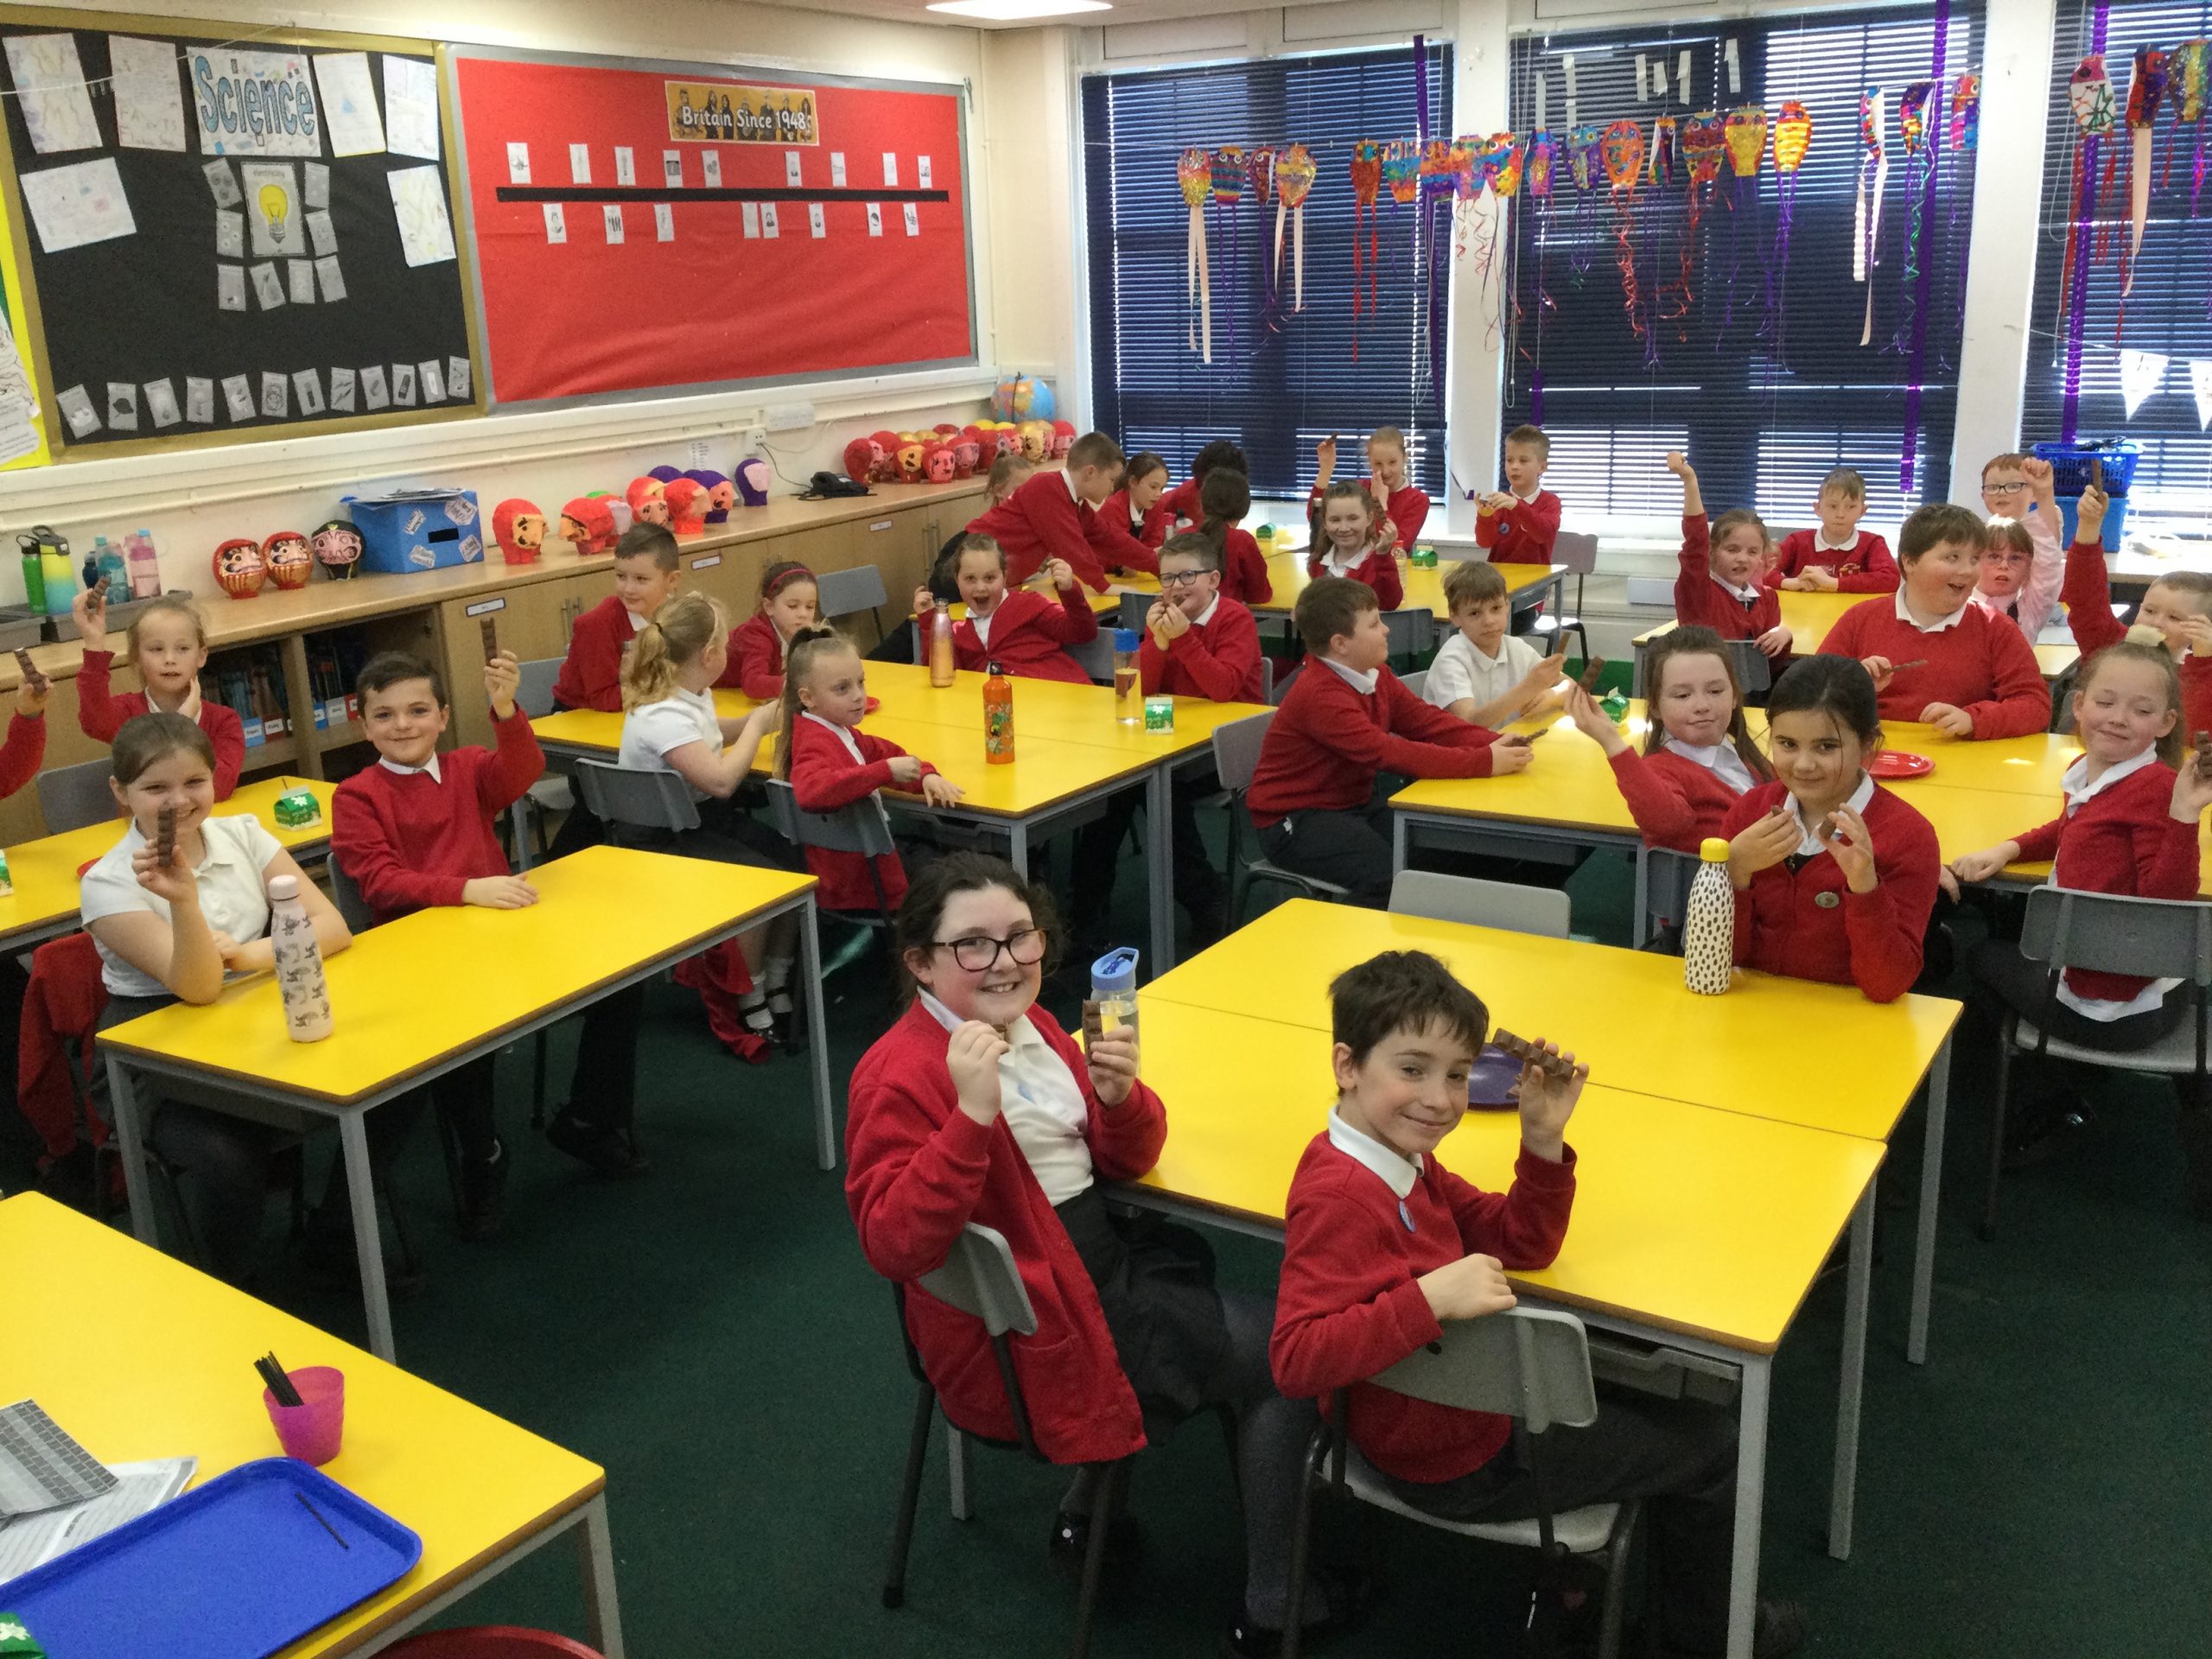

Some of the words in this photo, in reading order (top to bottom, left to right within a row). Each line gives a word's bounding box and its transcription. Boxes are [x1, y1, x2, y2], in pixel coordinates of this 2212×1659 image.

[194, 55, 315, 136] Science
[682, 105, 733, 127] Britain
[736, 108, 772, 129] Since
[776, 110, 807, 130] 1948
